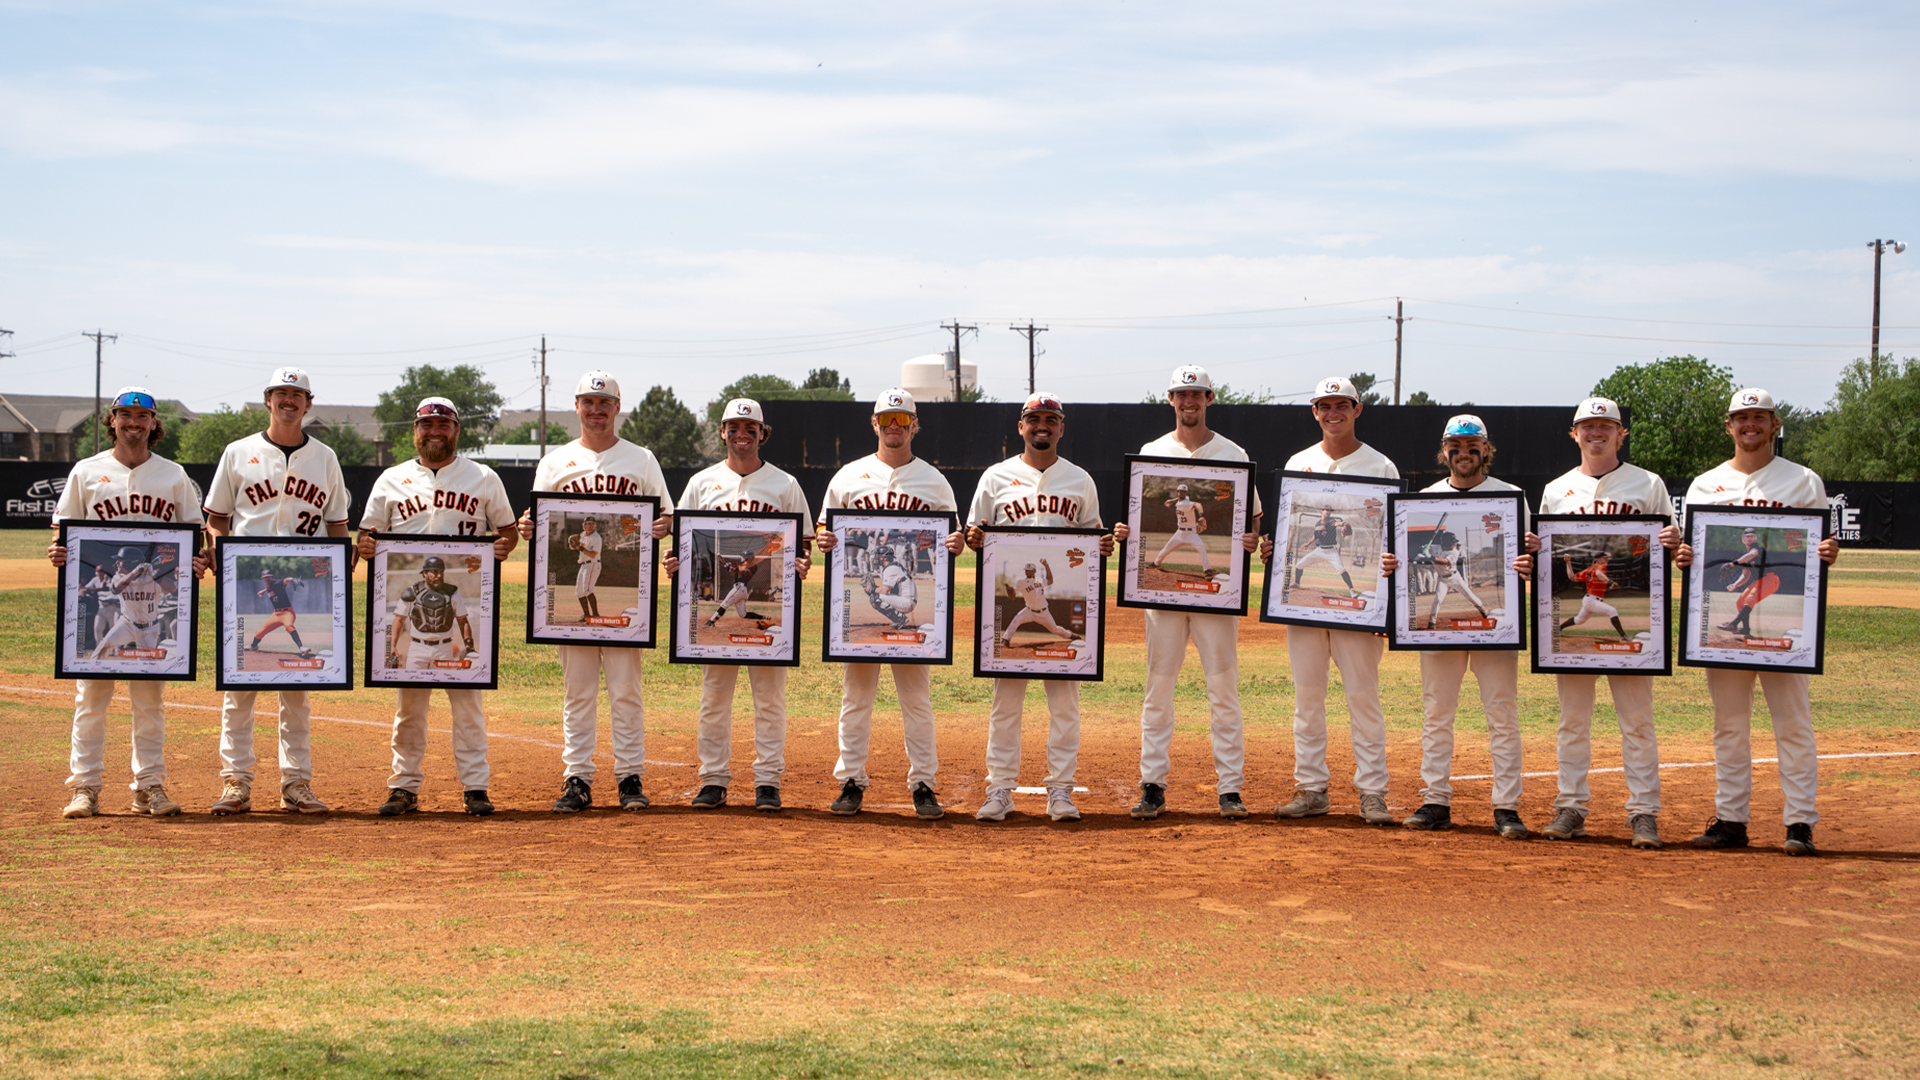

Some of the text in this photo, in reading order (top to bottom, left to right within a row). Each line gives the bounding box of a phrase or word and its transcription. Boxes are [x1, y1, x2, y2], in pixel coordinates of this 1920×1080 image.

[245, 476, 327, 509] FALCONS
[7, 499, 42, 512] First
[93, 494, 175, 523] FALCONS
[397, 489, 479, 520] FALCONS
[1004, 494, 1078, 523] FALCONS
[296, 511, 321, 537] 28
[458, 521, 477, 535] 17
[1832, 531, 1860, 540] LTIES
[1286, 551, 1294, 565] 2025
[122, 592, 155, 601] FALCONS
[1702, 589, 1710, 604] 2025
[1702, 606, 1710, 631] BASEBALL
